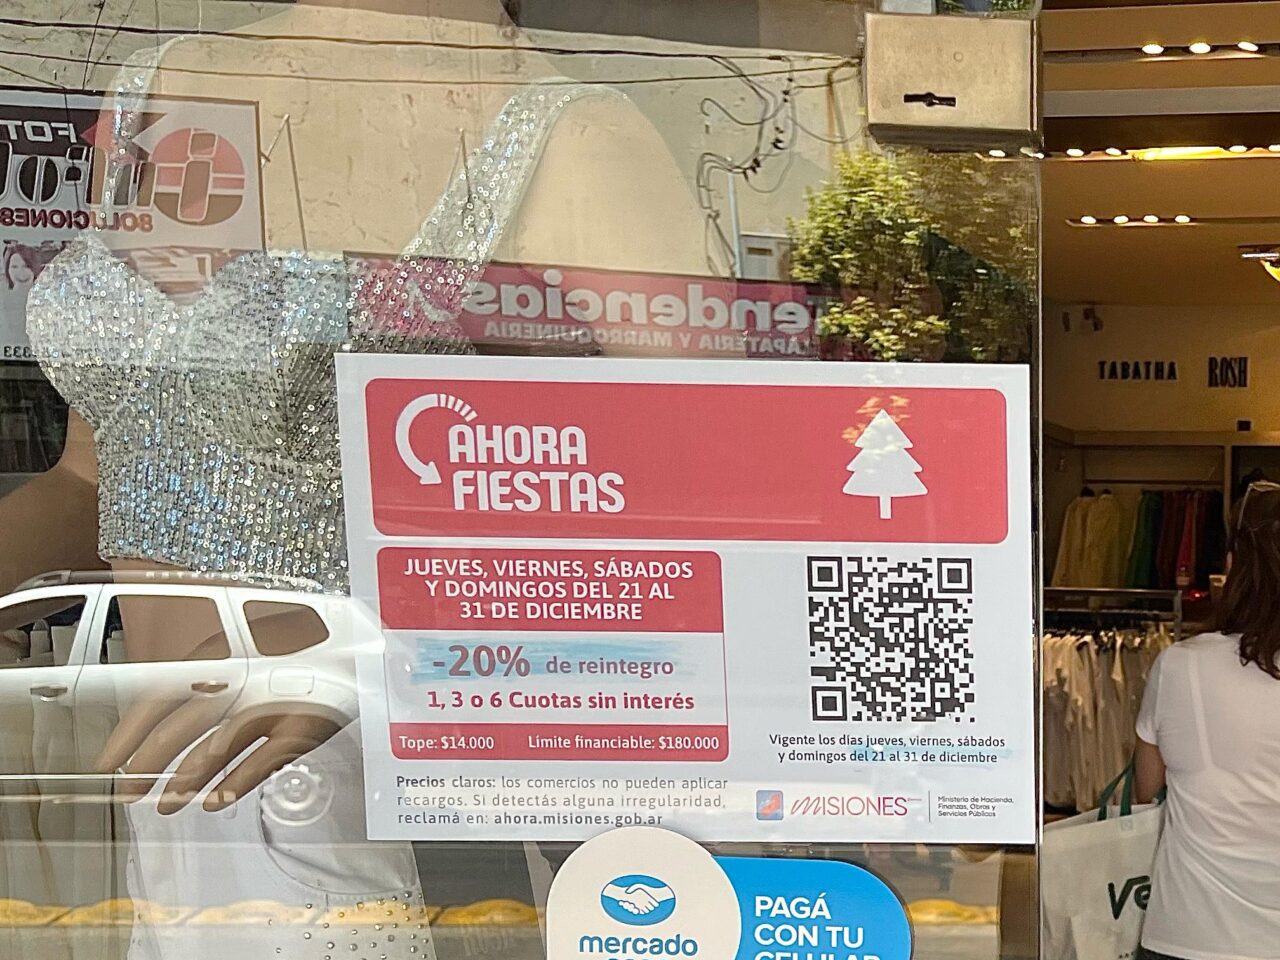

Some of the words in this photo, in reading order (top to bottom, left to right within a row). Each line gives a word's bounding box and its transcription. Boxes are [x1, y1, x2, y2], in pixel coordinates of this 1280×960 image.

[1098, 361, 1176, 380] TABATHA
[1208, 357, 1248, 387] ROSH
[449, 424, 587, 464] AHORA
[453, 470, 625, 513] FIESTAS
[404, 559, 488, 578] JUEVES,
[496, 560, 588, 579] VIERNES,
[594, 557, 693, 579] SÁBADOS
[425, 580, 439, 596] Y
[445, 580, 567, 598] DOMINGOS
[573, 582, 612, 599] DEL
[619, 582, 643, 599] 21
[649, 583, 675, 600] AL
[460, 602, 482, 618] 31
[492, 603, 519, 618] DE
[526, 603, 642, 620] DICIEMBRE
[433, 644, 530, 678] -20%
[546, 656, 571, 674] de
[579, 656, 674, 679] reintegro
[428, 691, 446, 711] 1,
[452, 691, 463, 708] 3
[471, 696, 483, 709] o
[490, 692, 501, 709] 6
[509, 692, 582, 709] Cuotas
[588, 692, 616, 709] sin
[623, 692, 695, 710] interés
[399, 736, 437, 751] Tope:
[441, 736, 494, 751] $14.000
[575, 735, 655, 749] financiable:
[659, 736, 720, 750] $180.000
[769, 734, 815, 747] Vigente
[819, 734, 835, 745] los
[839, 735, 863, 745] días
[866, 735, 907, 748] jueves,
[910, 736, 955, 748] viernes,
[958, 736, 1005, 747] sábados
[778, 753, 785, 762] y
[788, 750, 846, 763] domingos
[850, 751, 868, 761] del
[871, 751, 886, 761] 21
[889, 751, 900, 761] al
[904, 752, 918, 761] 31
[922, 751, 935, 762] de
[939, 751, 997, 763] diciembre
[397, 776, 445, 788] Precios
[452, 776, 496, 788] claros:
[502, 776, 520, 788] los
[527, 777, 596, 788] comercios
[603, 779, 618, 789] no
[626, 777, 675, 791] pueden
[682, 777, 727, 791] aplicar
[397, 796, 467, 809] recargos.
[493, 794, 557, 806] detectás
[563, 794, 614, 809] alguna
[790, 796, 908, 816] MISIONES
[399, 812, 460, 824] reclamá
[467, 814, 488, 824] en:
[494, 812, 662, 827] ahora.misiones.gob.ar
[755, 893, 831, 920] PAGÁ
[579, 934, 698, 956] mercado
[754, 924, 818, 947] CON
[825, 926, 864, 948] TU
